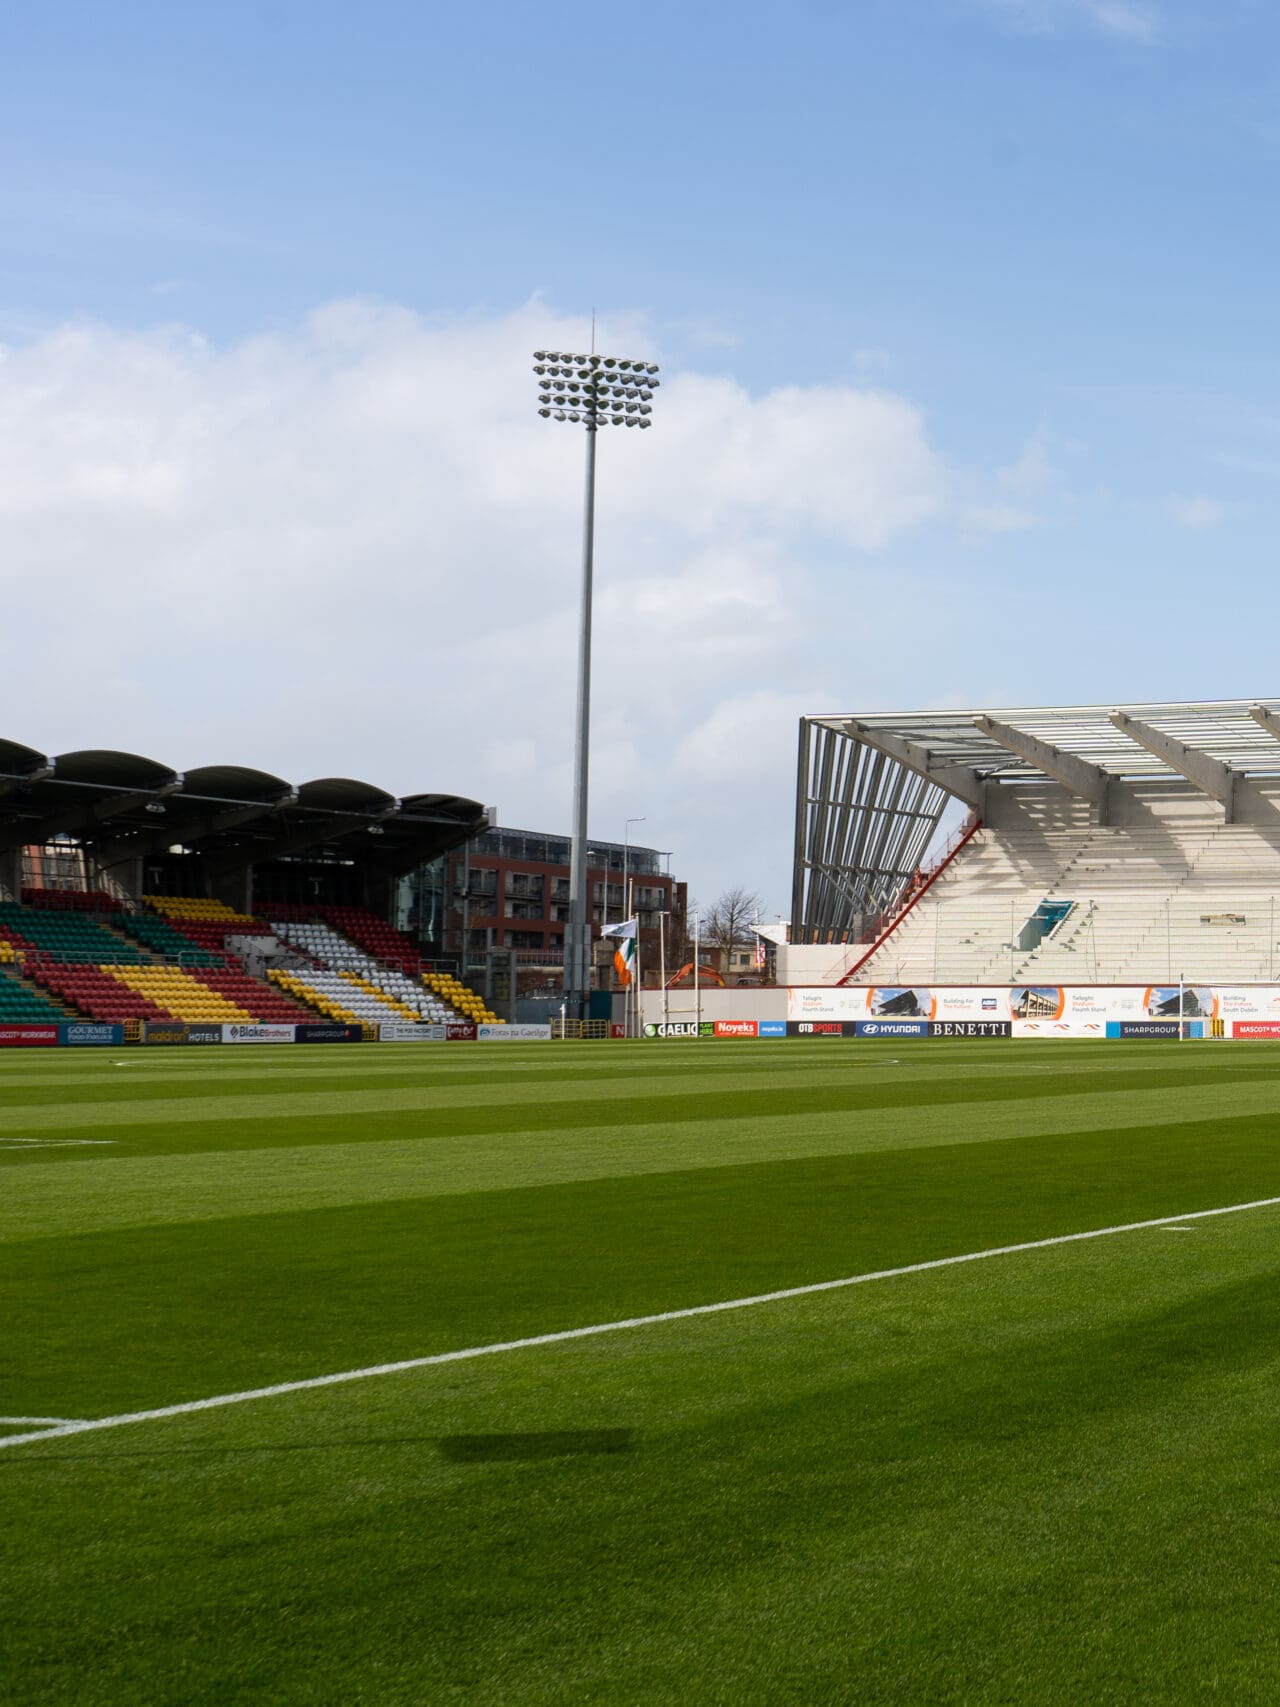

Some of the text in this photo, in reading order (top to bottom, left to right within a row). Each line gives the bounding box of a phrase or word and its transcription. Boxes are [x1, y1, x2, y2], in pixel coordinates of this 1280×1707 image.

[68, 1026, 113, 1034] GOURMET
[657, 1023, 697, 1036] GAELIC
[718, 1022, 754, 1034] Noyeks
[880, 1025, 921, 1033] HYUNDAI
[934, 1023, 1007, 1036] BENETTI
[1124, 1026, 1177, 1034] SHARPGROUP
[188, 1032, 220, 1042] HOTELS
